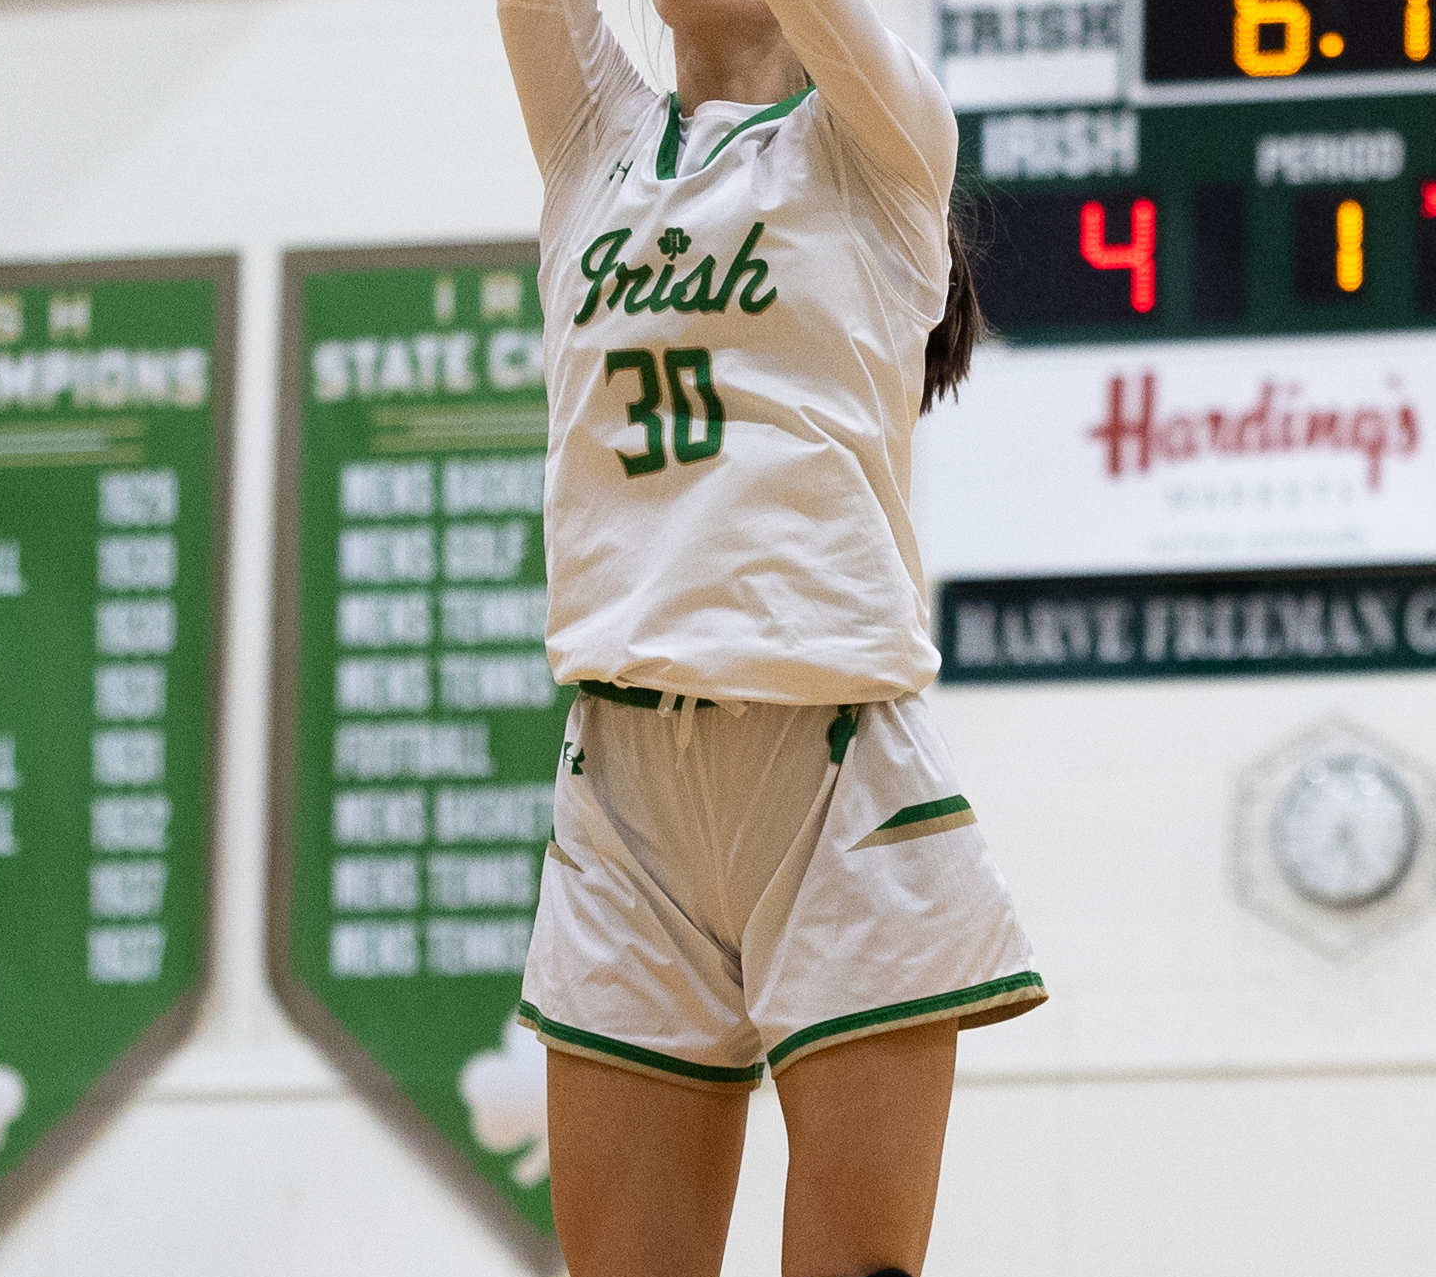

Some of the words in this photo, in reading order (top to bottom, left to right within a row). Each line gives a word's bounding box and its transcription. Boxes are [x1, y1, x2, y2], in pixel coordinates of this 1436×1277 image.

[981, 111, 1139, 180] IRISH
[1255, 131, 1405, 185] PERIOD
[572, 221, 778, 326] Irish
[1078, 196, 1157, 314] 4
[1336, 198, 1364, 292] 1
[312, 329, 476, 403] STATE
[604, 346, 727, 481] 30
[1091, 370, 1421, 492] Harding's
